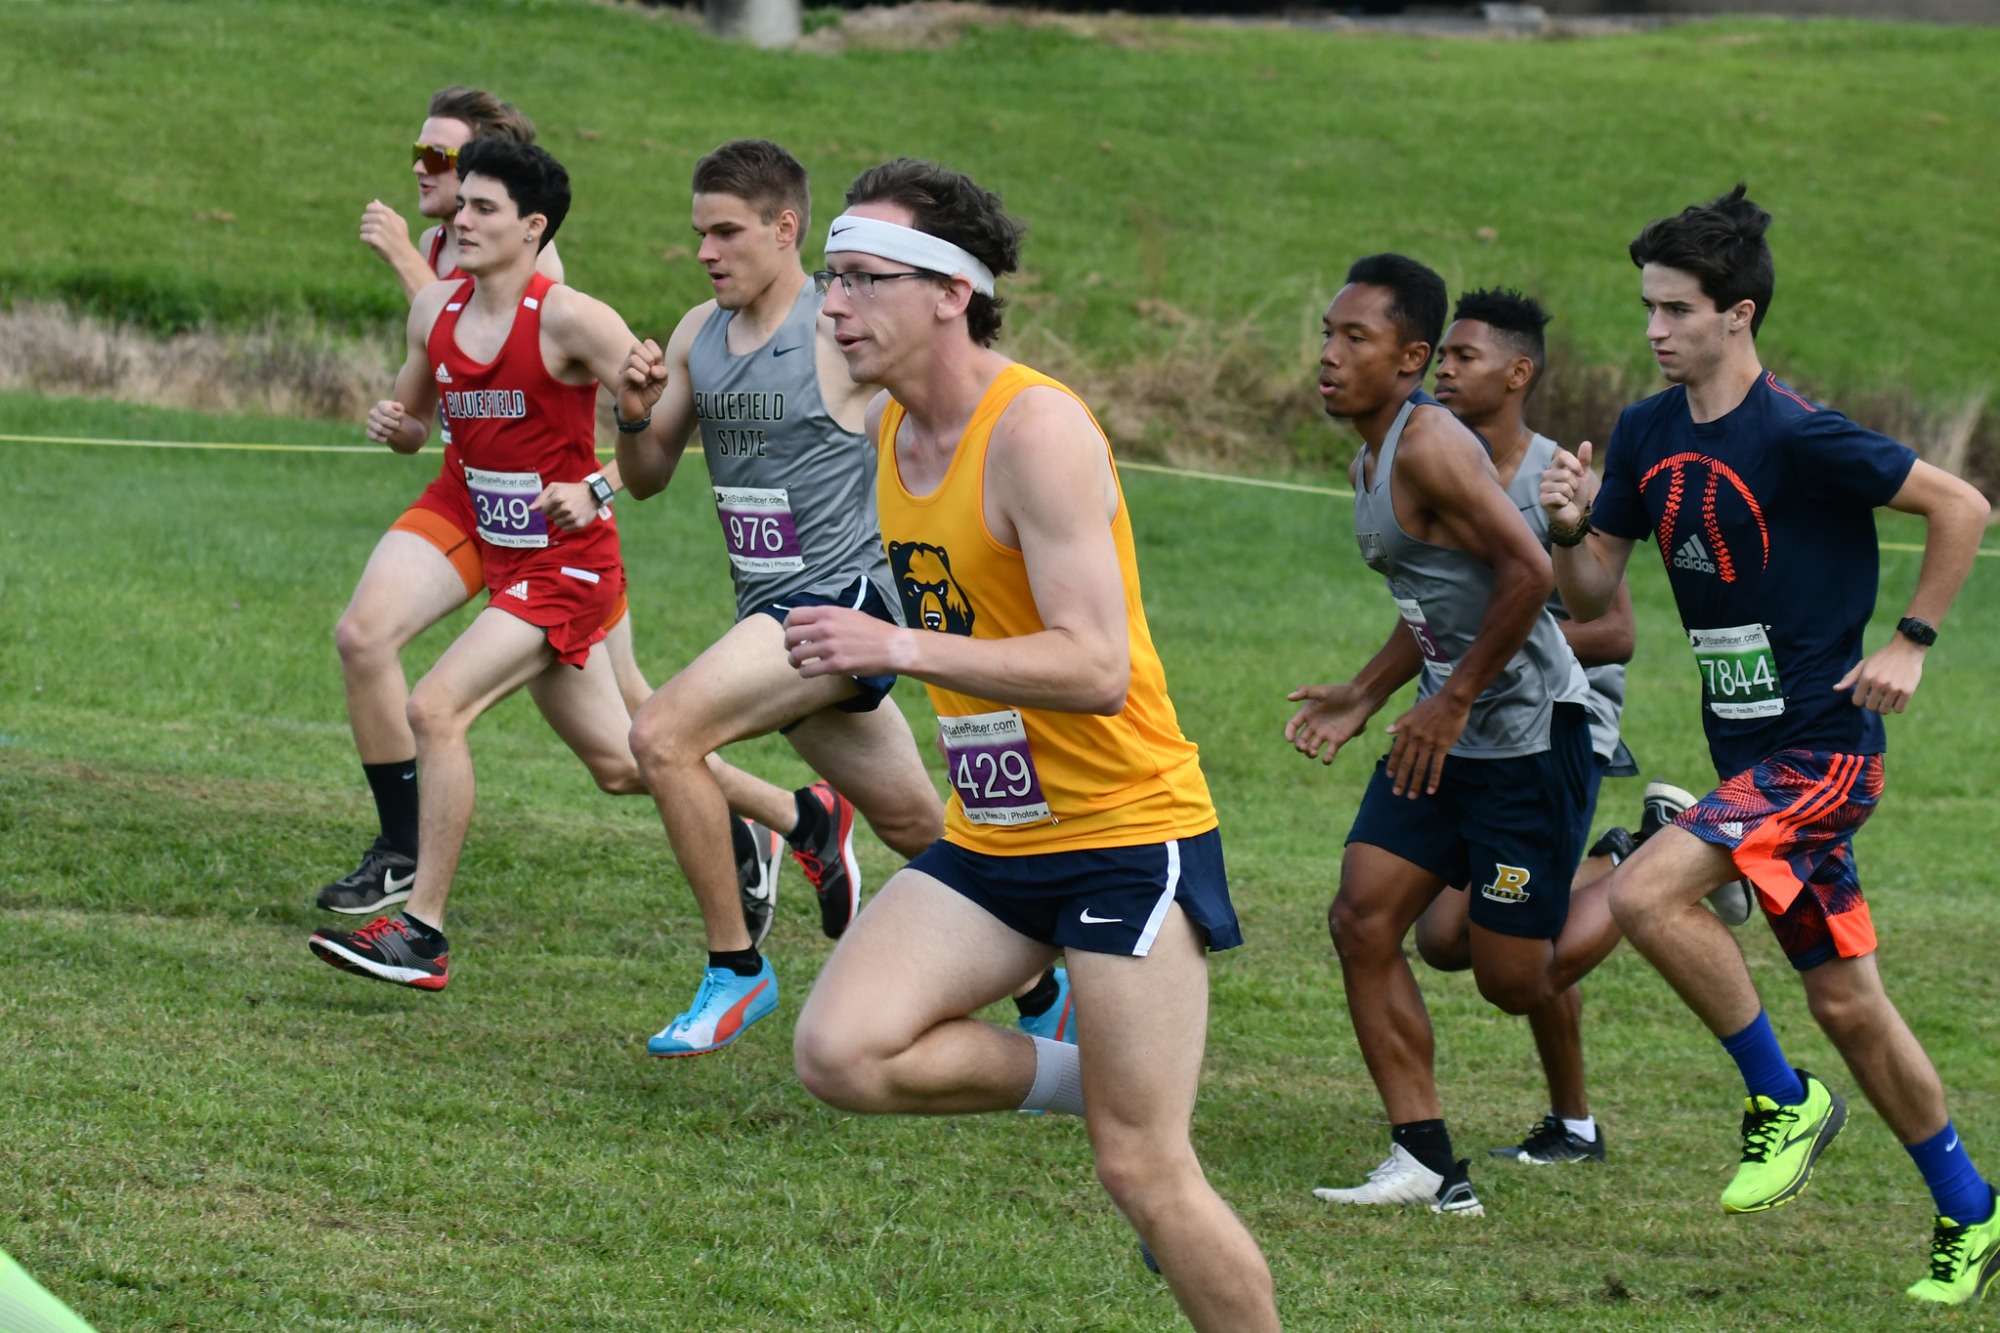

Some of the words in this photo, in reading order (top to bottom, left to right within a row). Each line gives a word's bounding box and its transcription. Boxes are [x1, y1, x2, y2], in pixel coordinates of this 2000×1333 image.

[445, 390, 526, 418] BLUEFIELD
[695, 391, 784, 421] BLUEFIELD
[717, 429, 766, 457] STATE
[477, 495, 530, 530] 349
[730, 516, 783, 552] 976
[1674, 556, 1716, 574] adidas
[1700, 655, 1775, 696] 7844
[941, 719, 1017, 736] StateRacer.com
[957, 750, 1031, 799] 429
[1010, 810, 1039, 820] Photos
